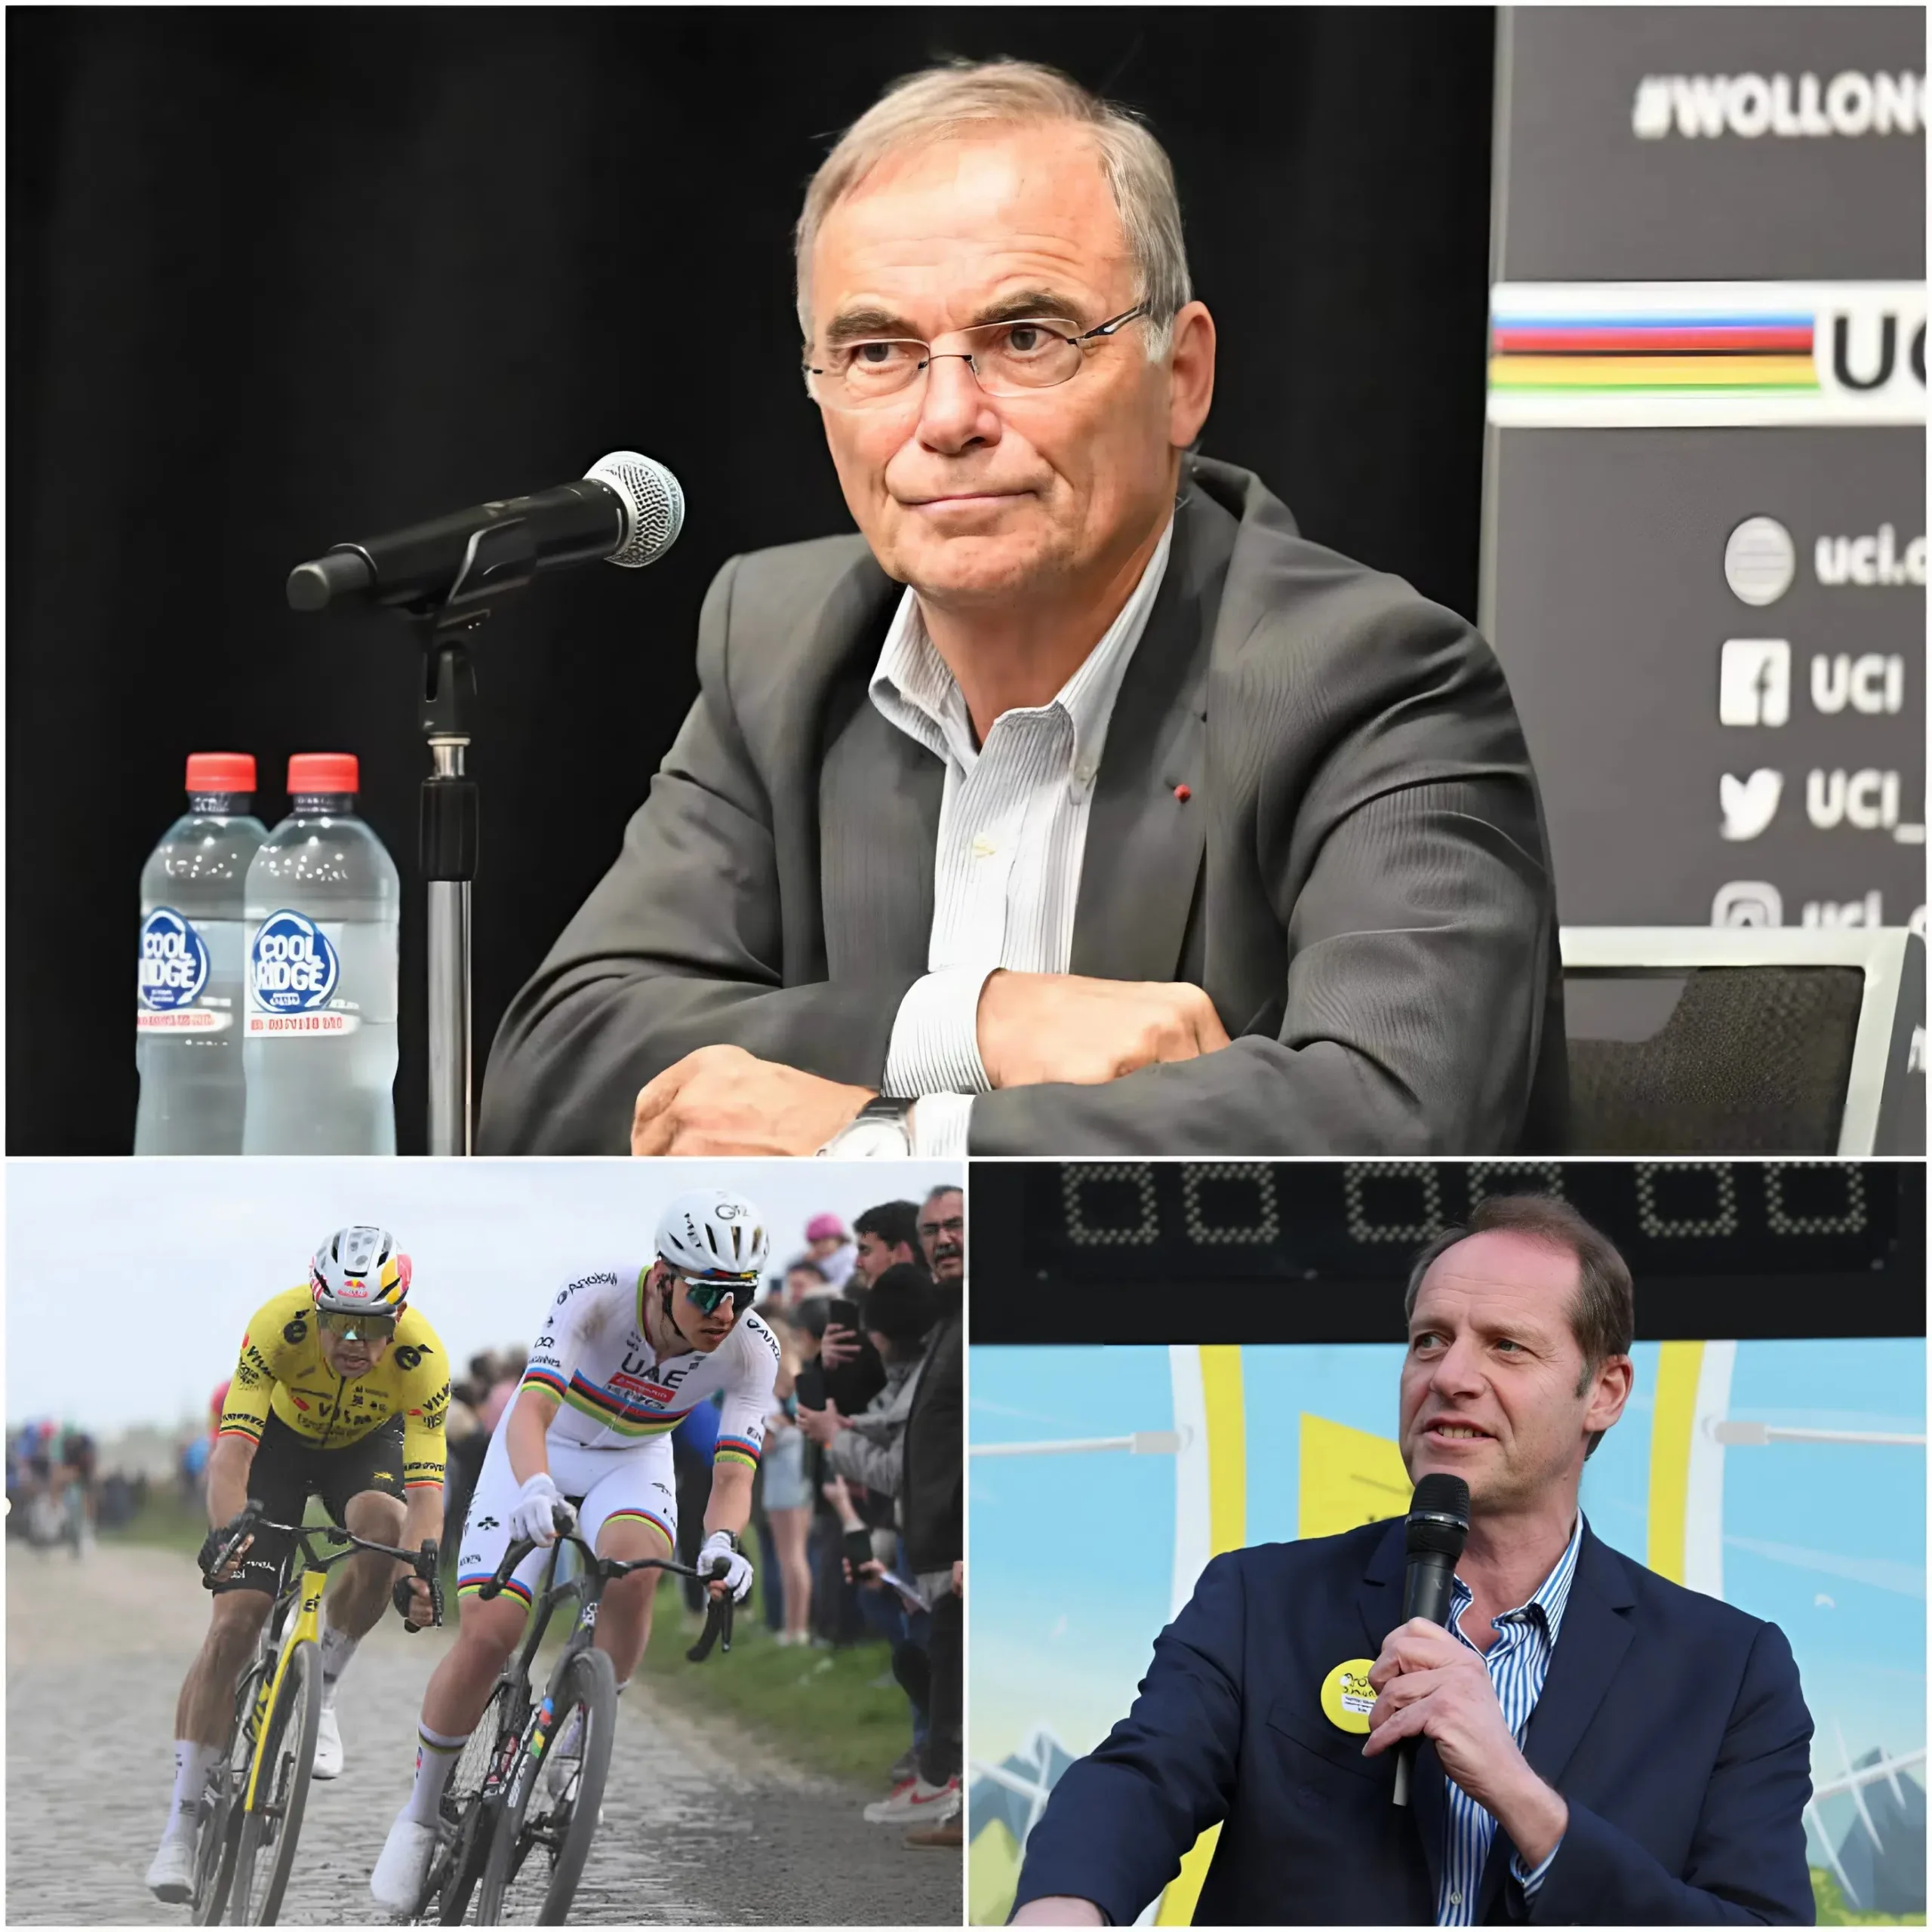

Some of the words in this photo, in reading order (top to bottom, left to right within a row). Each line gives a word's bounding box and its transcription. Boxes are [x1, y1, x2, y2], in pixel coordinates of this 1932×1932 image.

[1632, 69, 1926, 139] #WOLLON
[1810, 652, 1904, 715] UCI
[259, 934, 321, 964] COOL
[621, 1352, 688, 1389] UAE
